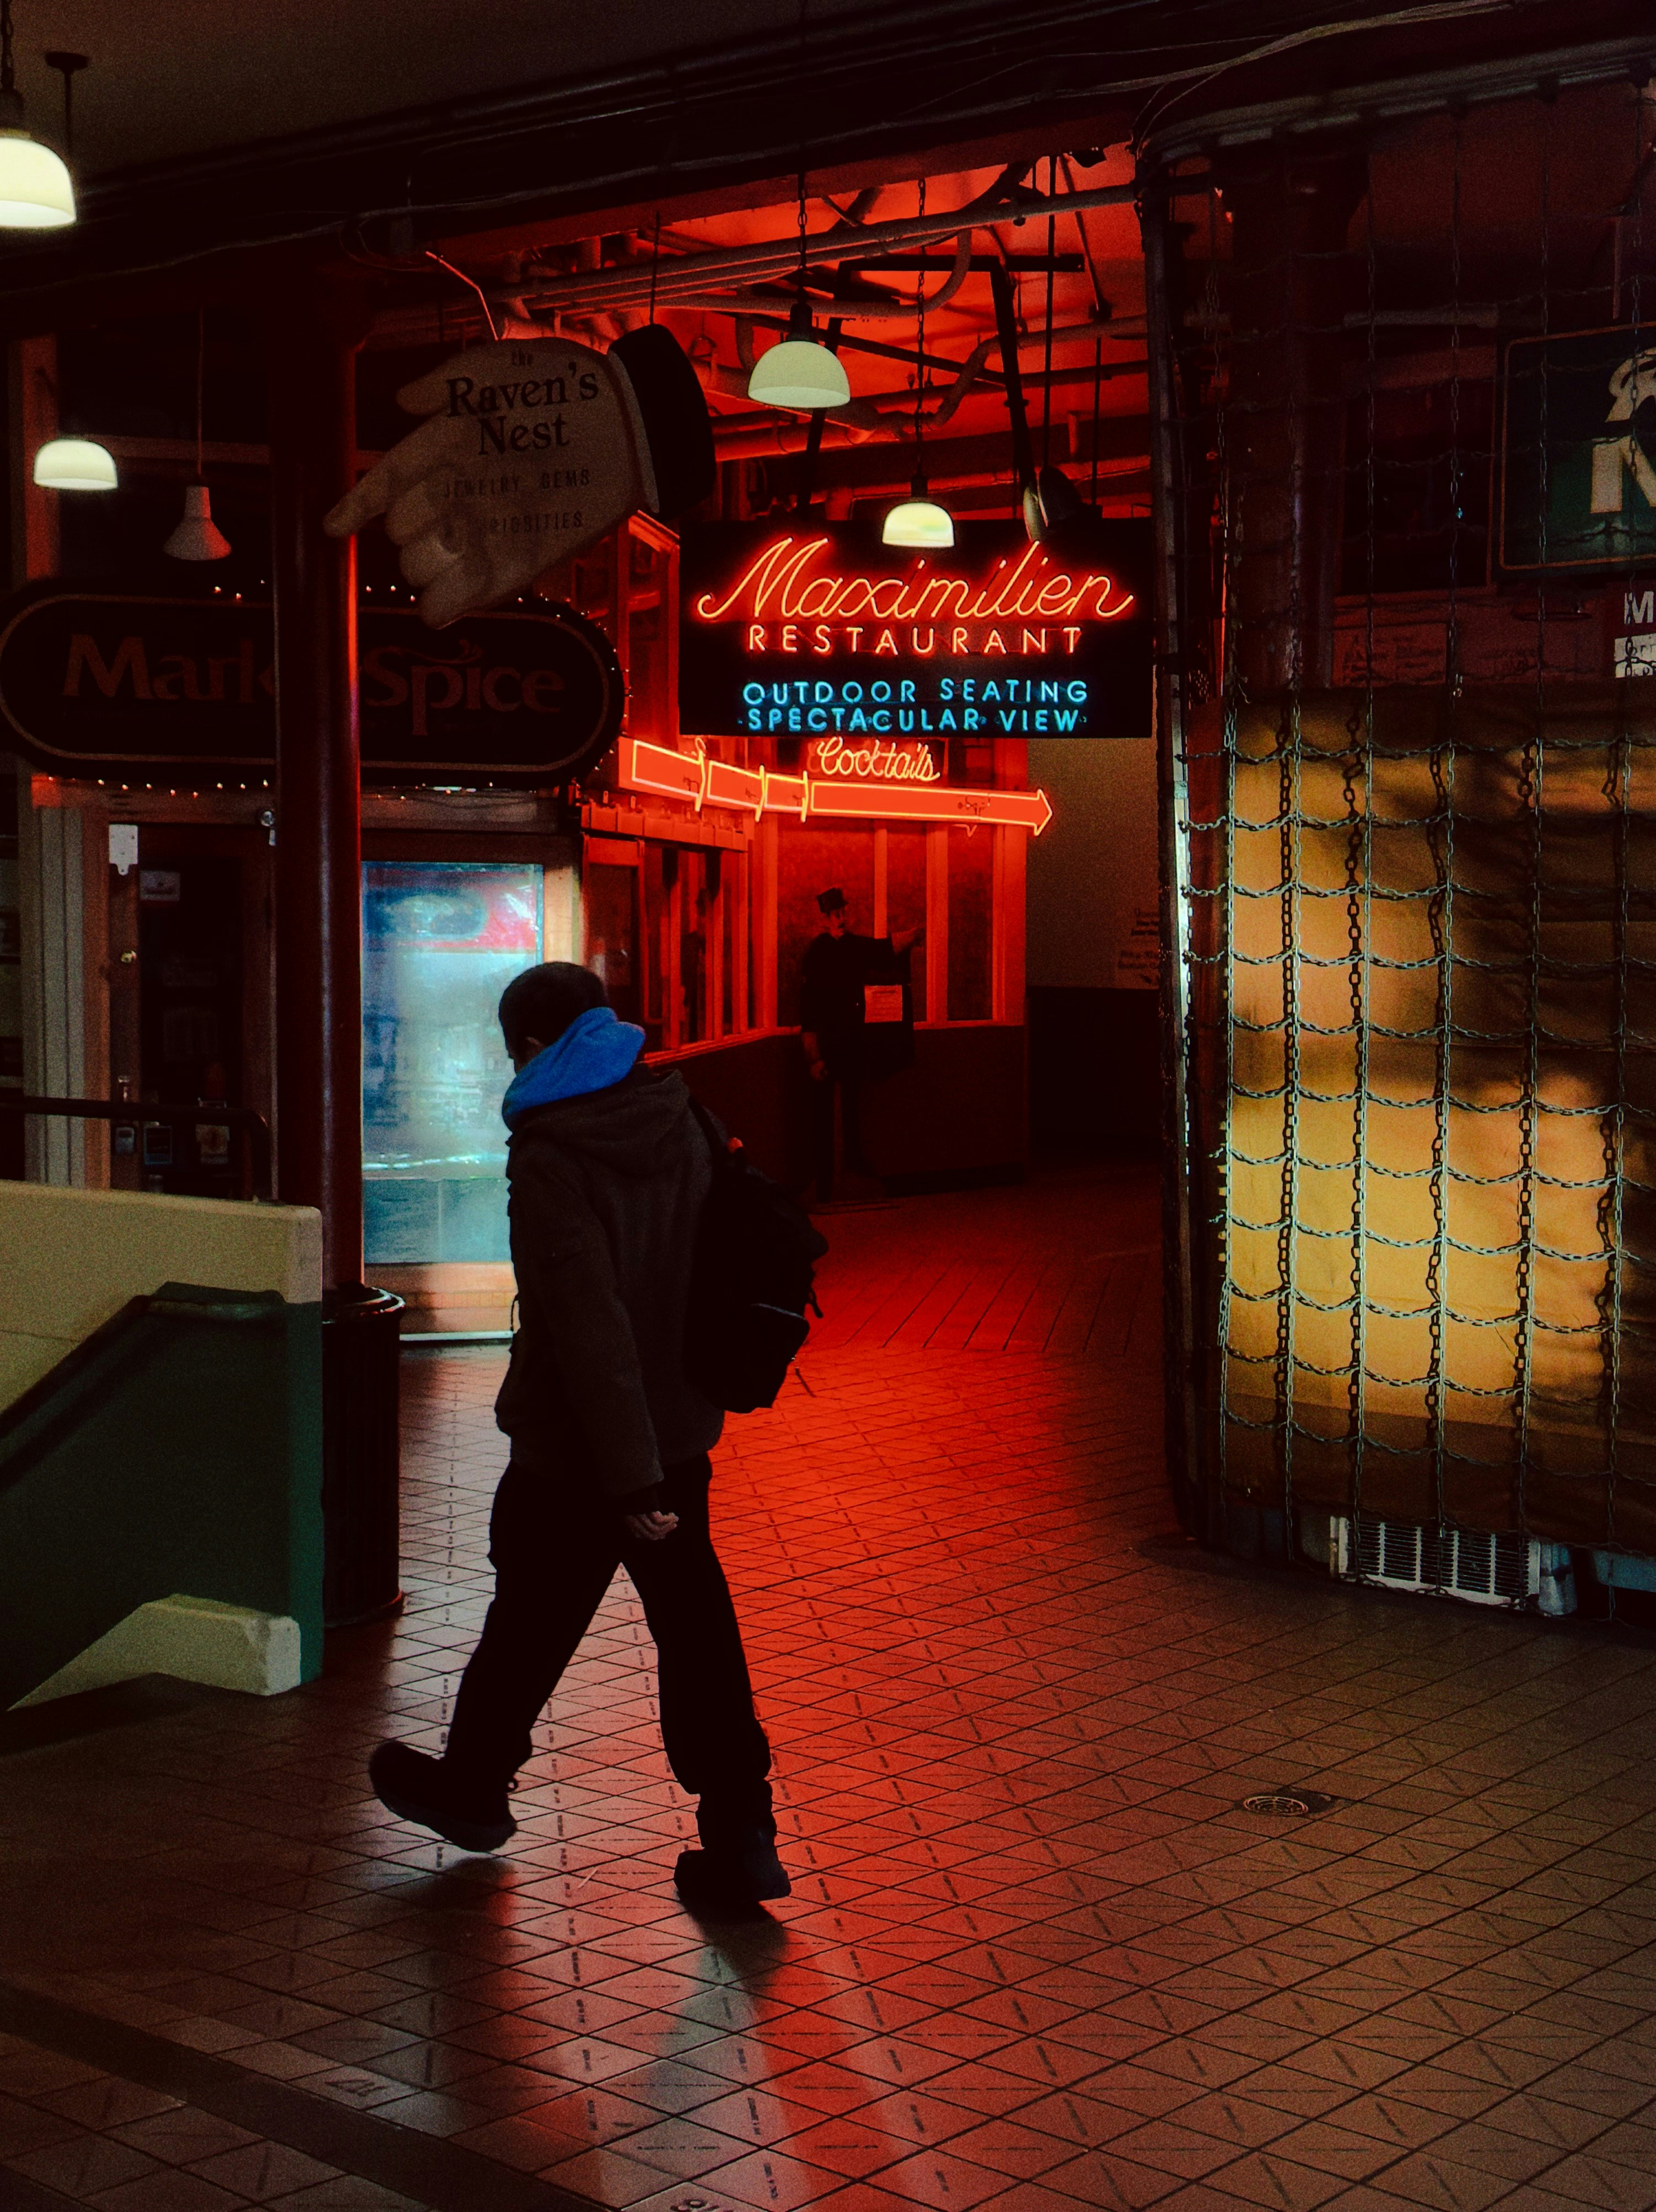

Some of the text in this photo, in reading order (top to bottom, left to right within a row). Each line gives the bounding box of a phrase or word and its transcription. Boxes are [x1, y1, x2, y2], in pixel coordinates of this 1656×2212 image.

[511, 349, 534, 366] the
[445, 362, 599, 417] Raven's
[477, 412, 570, 455] Nest
[540, 469, 589, 489] GEMS
[697, 536, 1135, 620] Maximilien
[748, 624, 1082, 656] RESTAURANT
[59, 633, 567, 737] Mark Spice
[743, 678, 1088, 706] OUTDOOR SEATING
[748, 707, 1079, 732] SPECTACULAR VIEW
[816, 735, 941, 782] Cocktails
